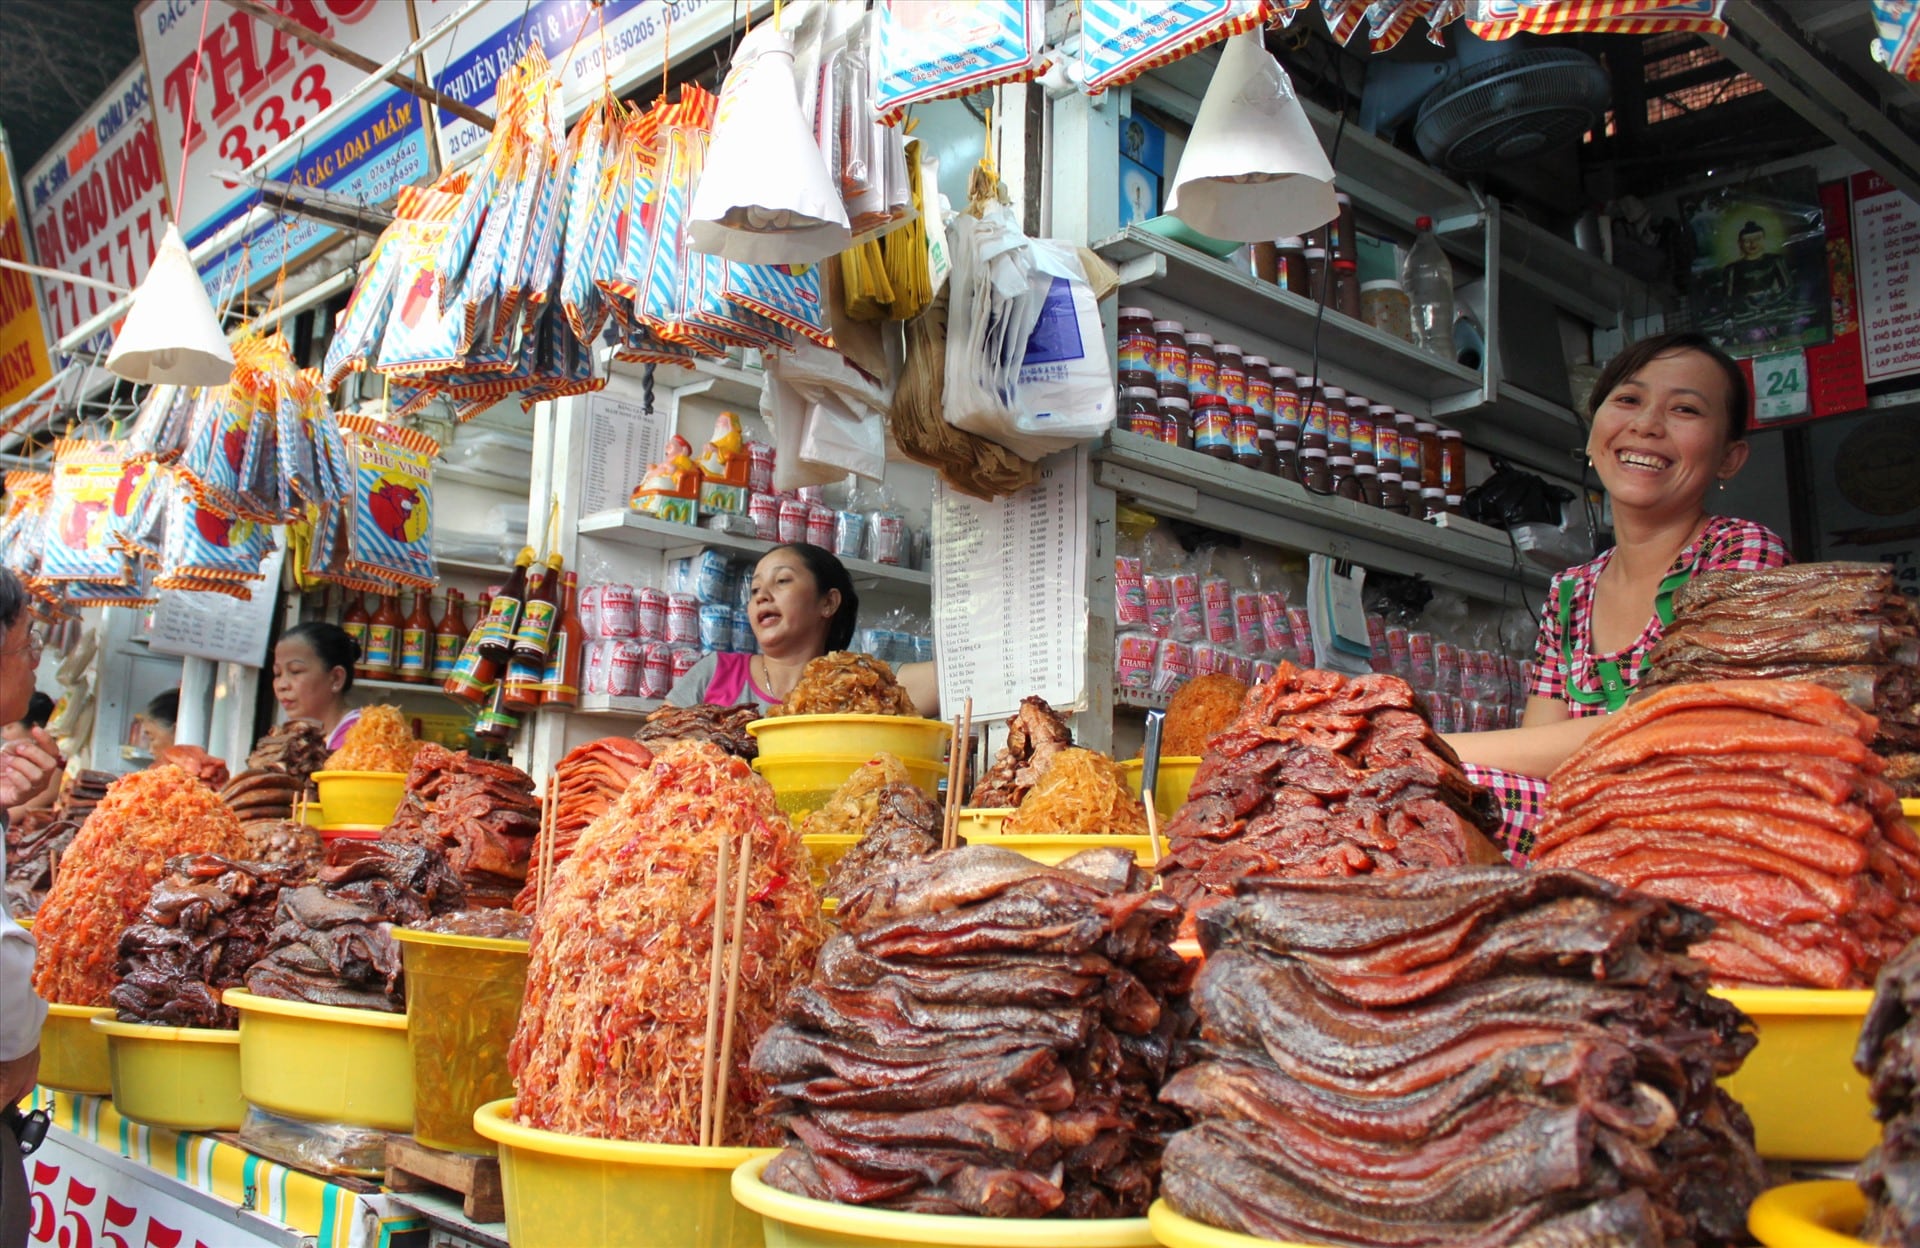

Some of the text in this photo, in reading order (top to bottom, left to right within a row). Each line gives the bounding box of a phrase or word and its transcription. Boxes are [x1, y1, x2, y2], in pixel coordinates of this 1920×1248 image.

[443, 55, 497, 102] CHUYÊN
[496, 33, 527, 79] BÁN
[547, 14, 561, 42] &
[306, 156, 334, 188] CÁC
[335, 130, 371, 170] LOẠI
[448, 125, 477, 155] 23 CHI
[1766, 367, 1800, 397] 24
